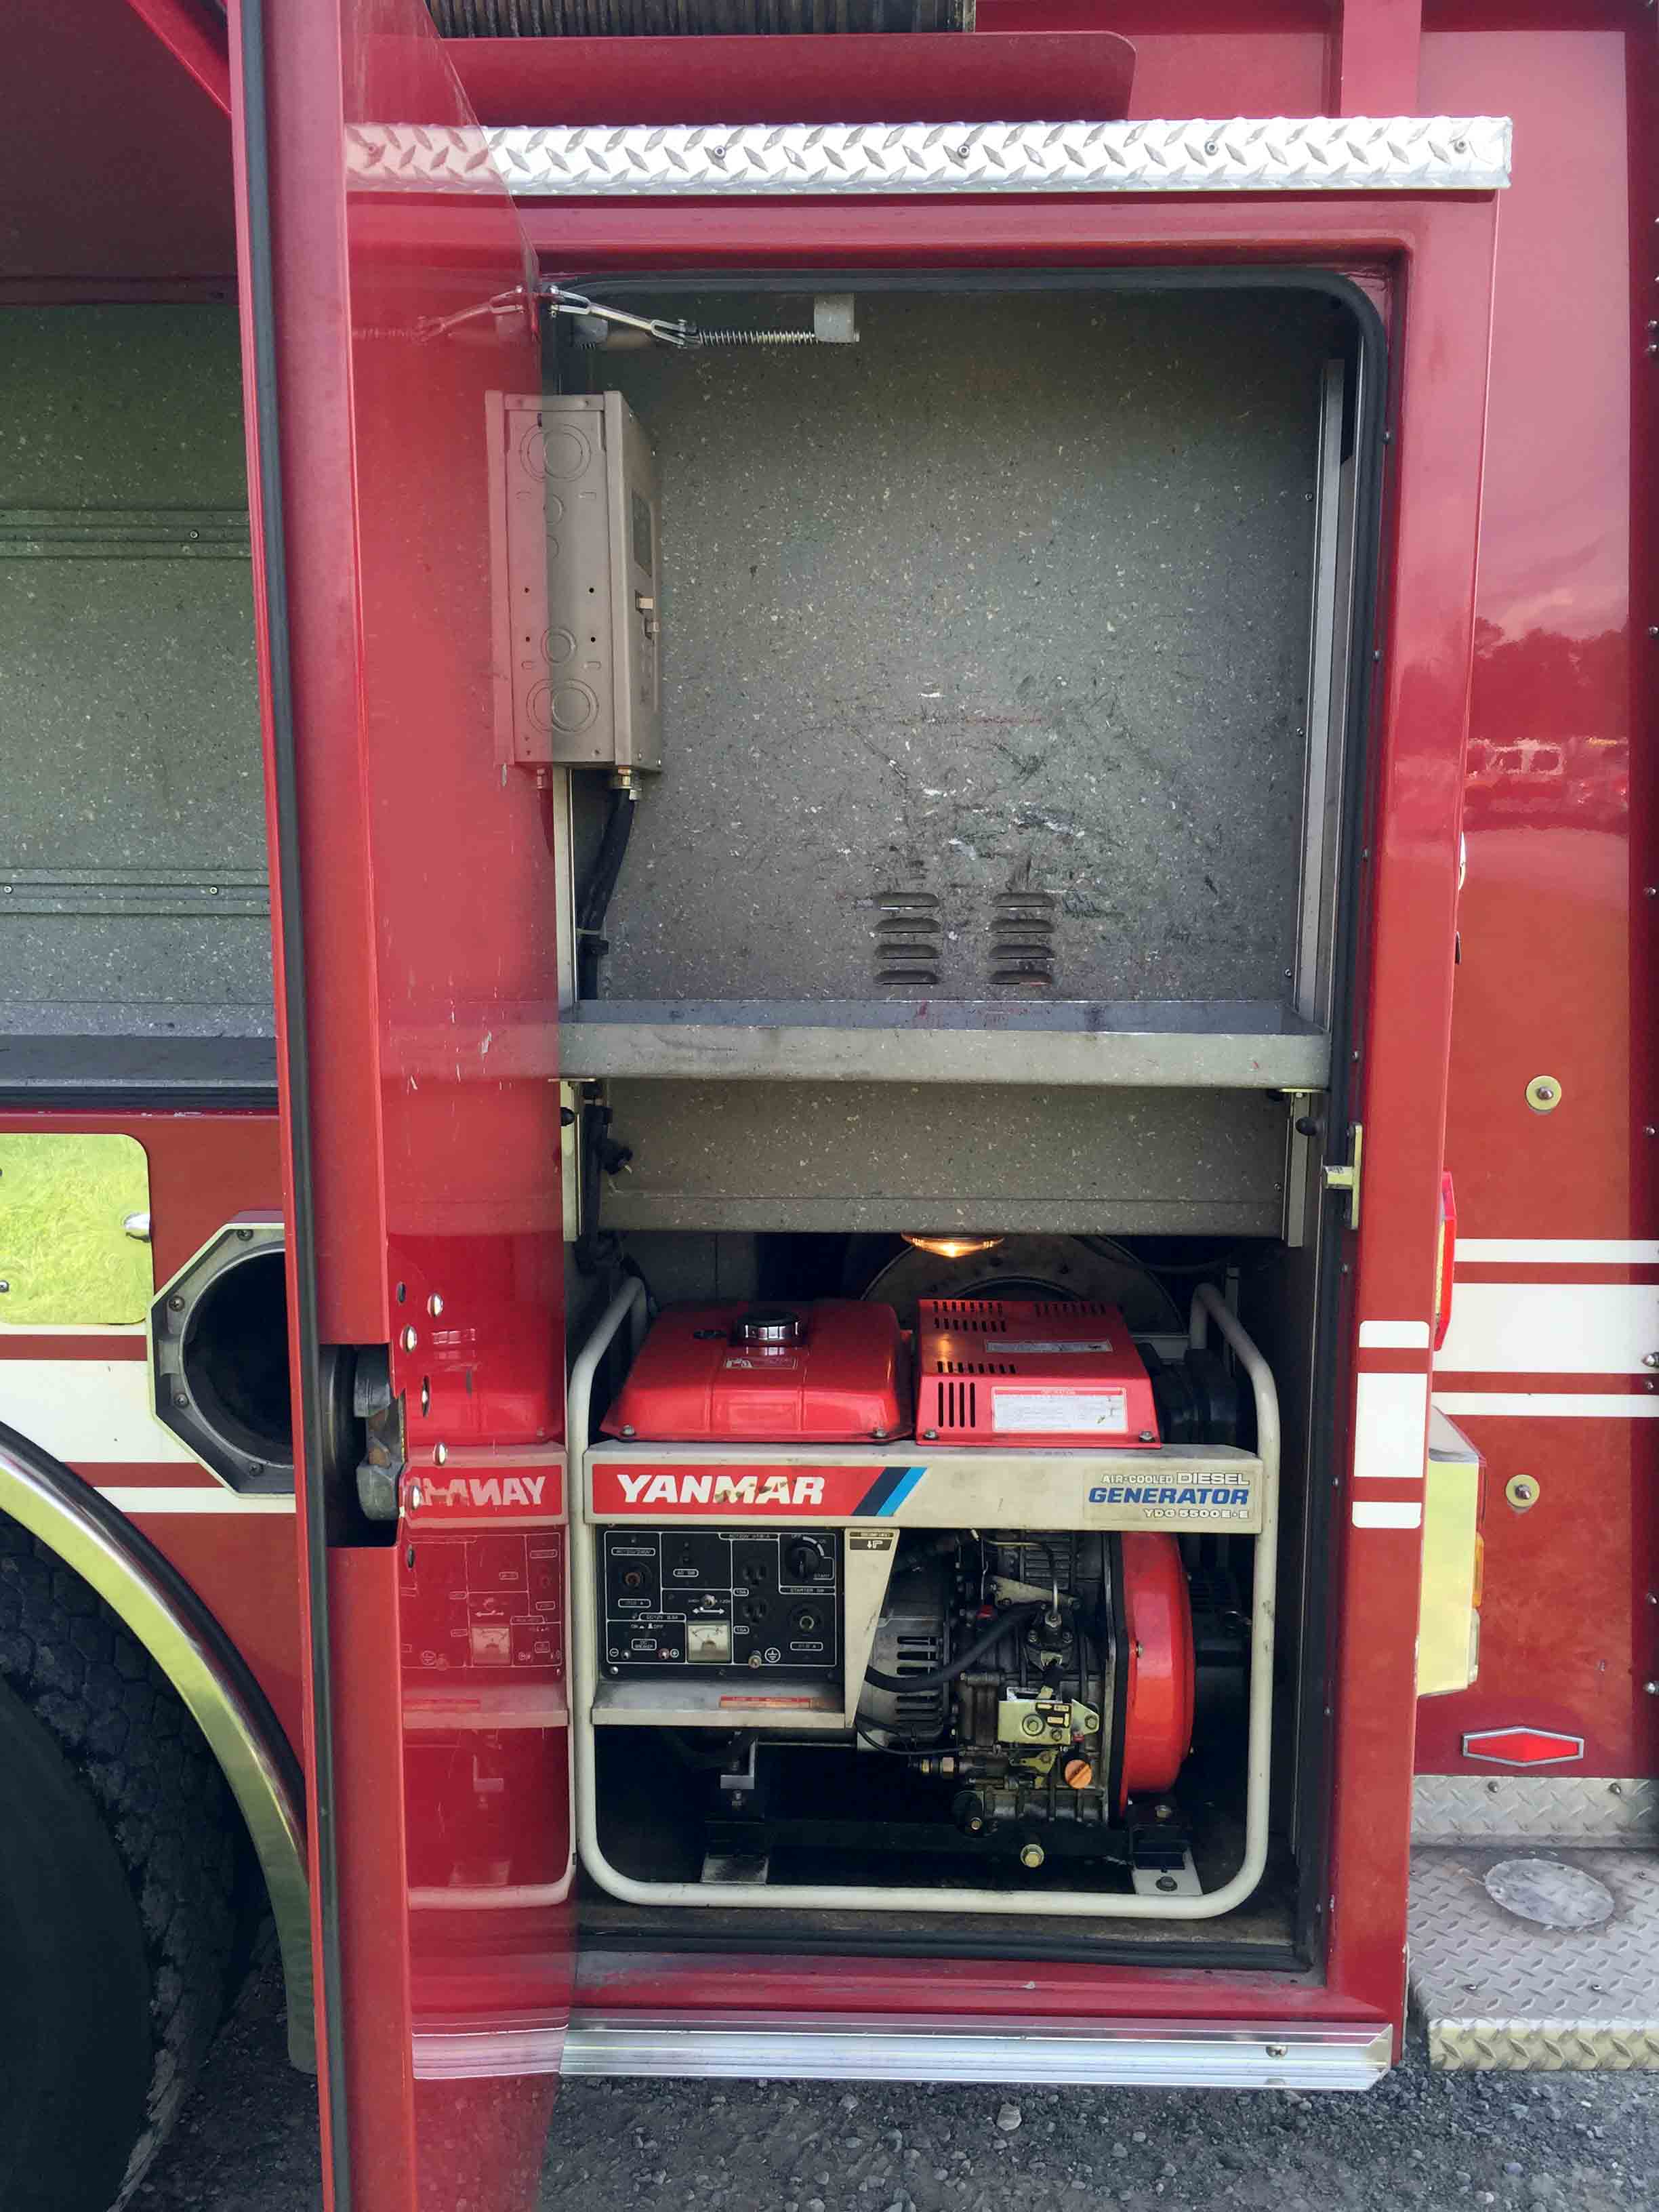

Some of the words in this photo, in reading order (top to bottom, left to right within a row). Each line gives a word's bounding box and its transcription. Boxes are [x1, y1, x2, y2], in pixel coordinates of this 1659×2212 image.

[1176, 1472, 1250, 1486] DIESEL
[617, 1474, 825, 1504] YANMAR
[1088, 1487, 1250, 1505] GENERATOR
[1144, 1508, 1176, 1519] YDG
